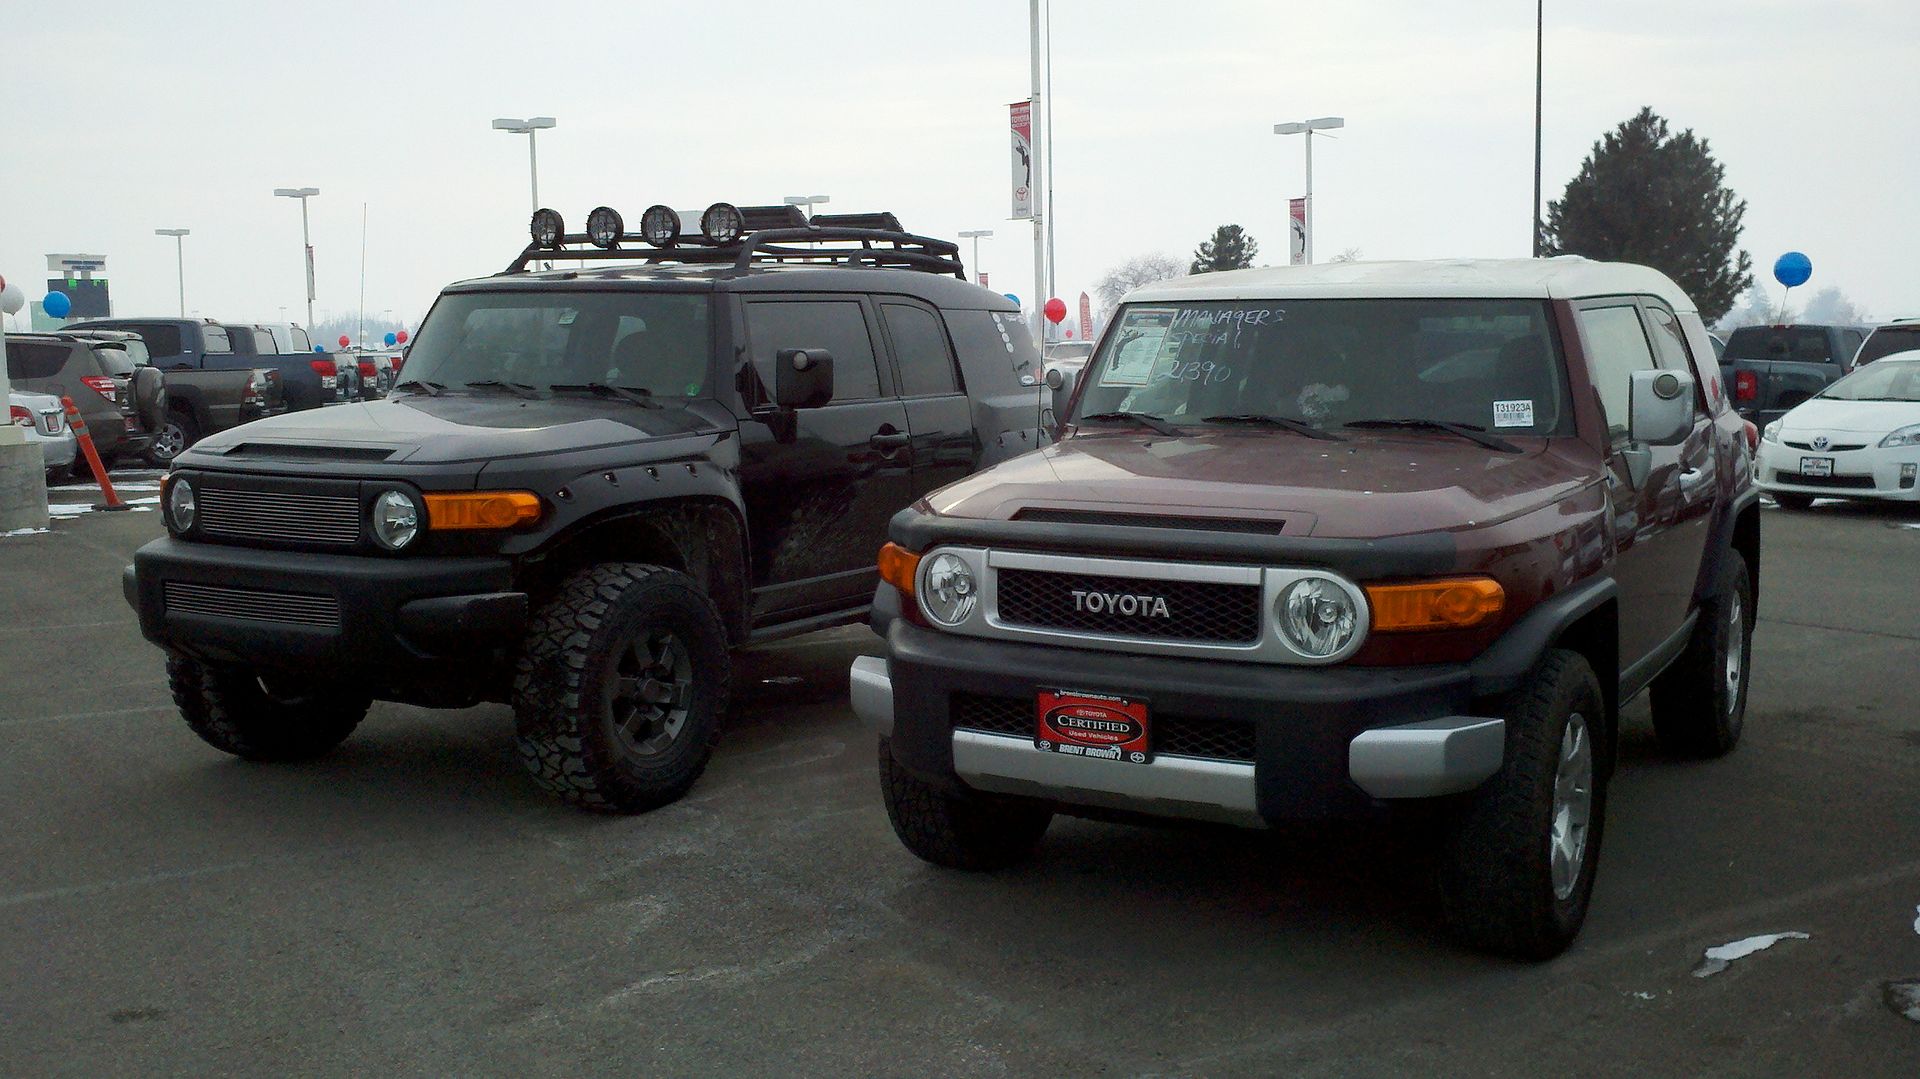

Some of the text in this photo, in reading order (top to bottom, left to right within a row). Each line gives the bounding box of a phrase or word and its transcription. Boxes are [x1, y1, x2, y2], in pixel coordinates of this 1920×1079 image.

[1495, 403, 1531, 412] T31923A
[1071, 590, 1170, 618] TOYOTA
[1085, 710, 1107, 718] TOYOTA
[1068, 730, 1119, 741] Used Vehicles
[1059, 743, 1116, 760] BRENT BROWN
